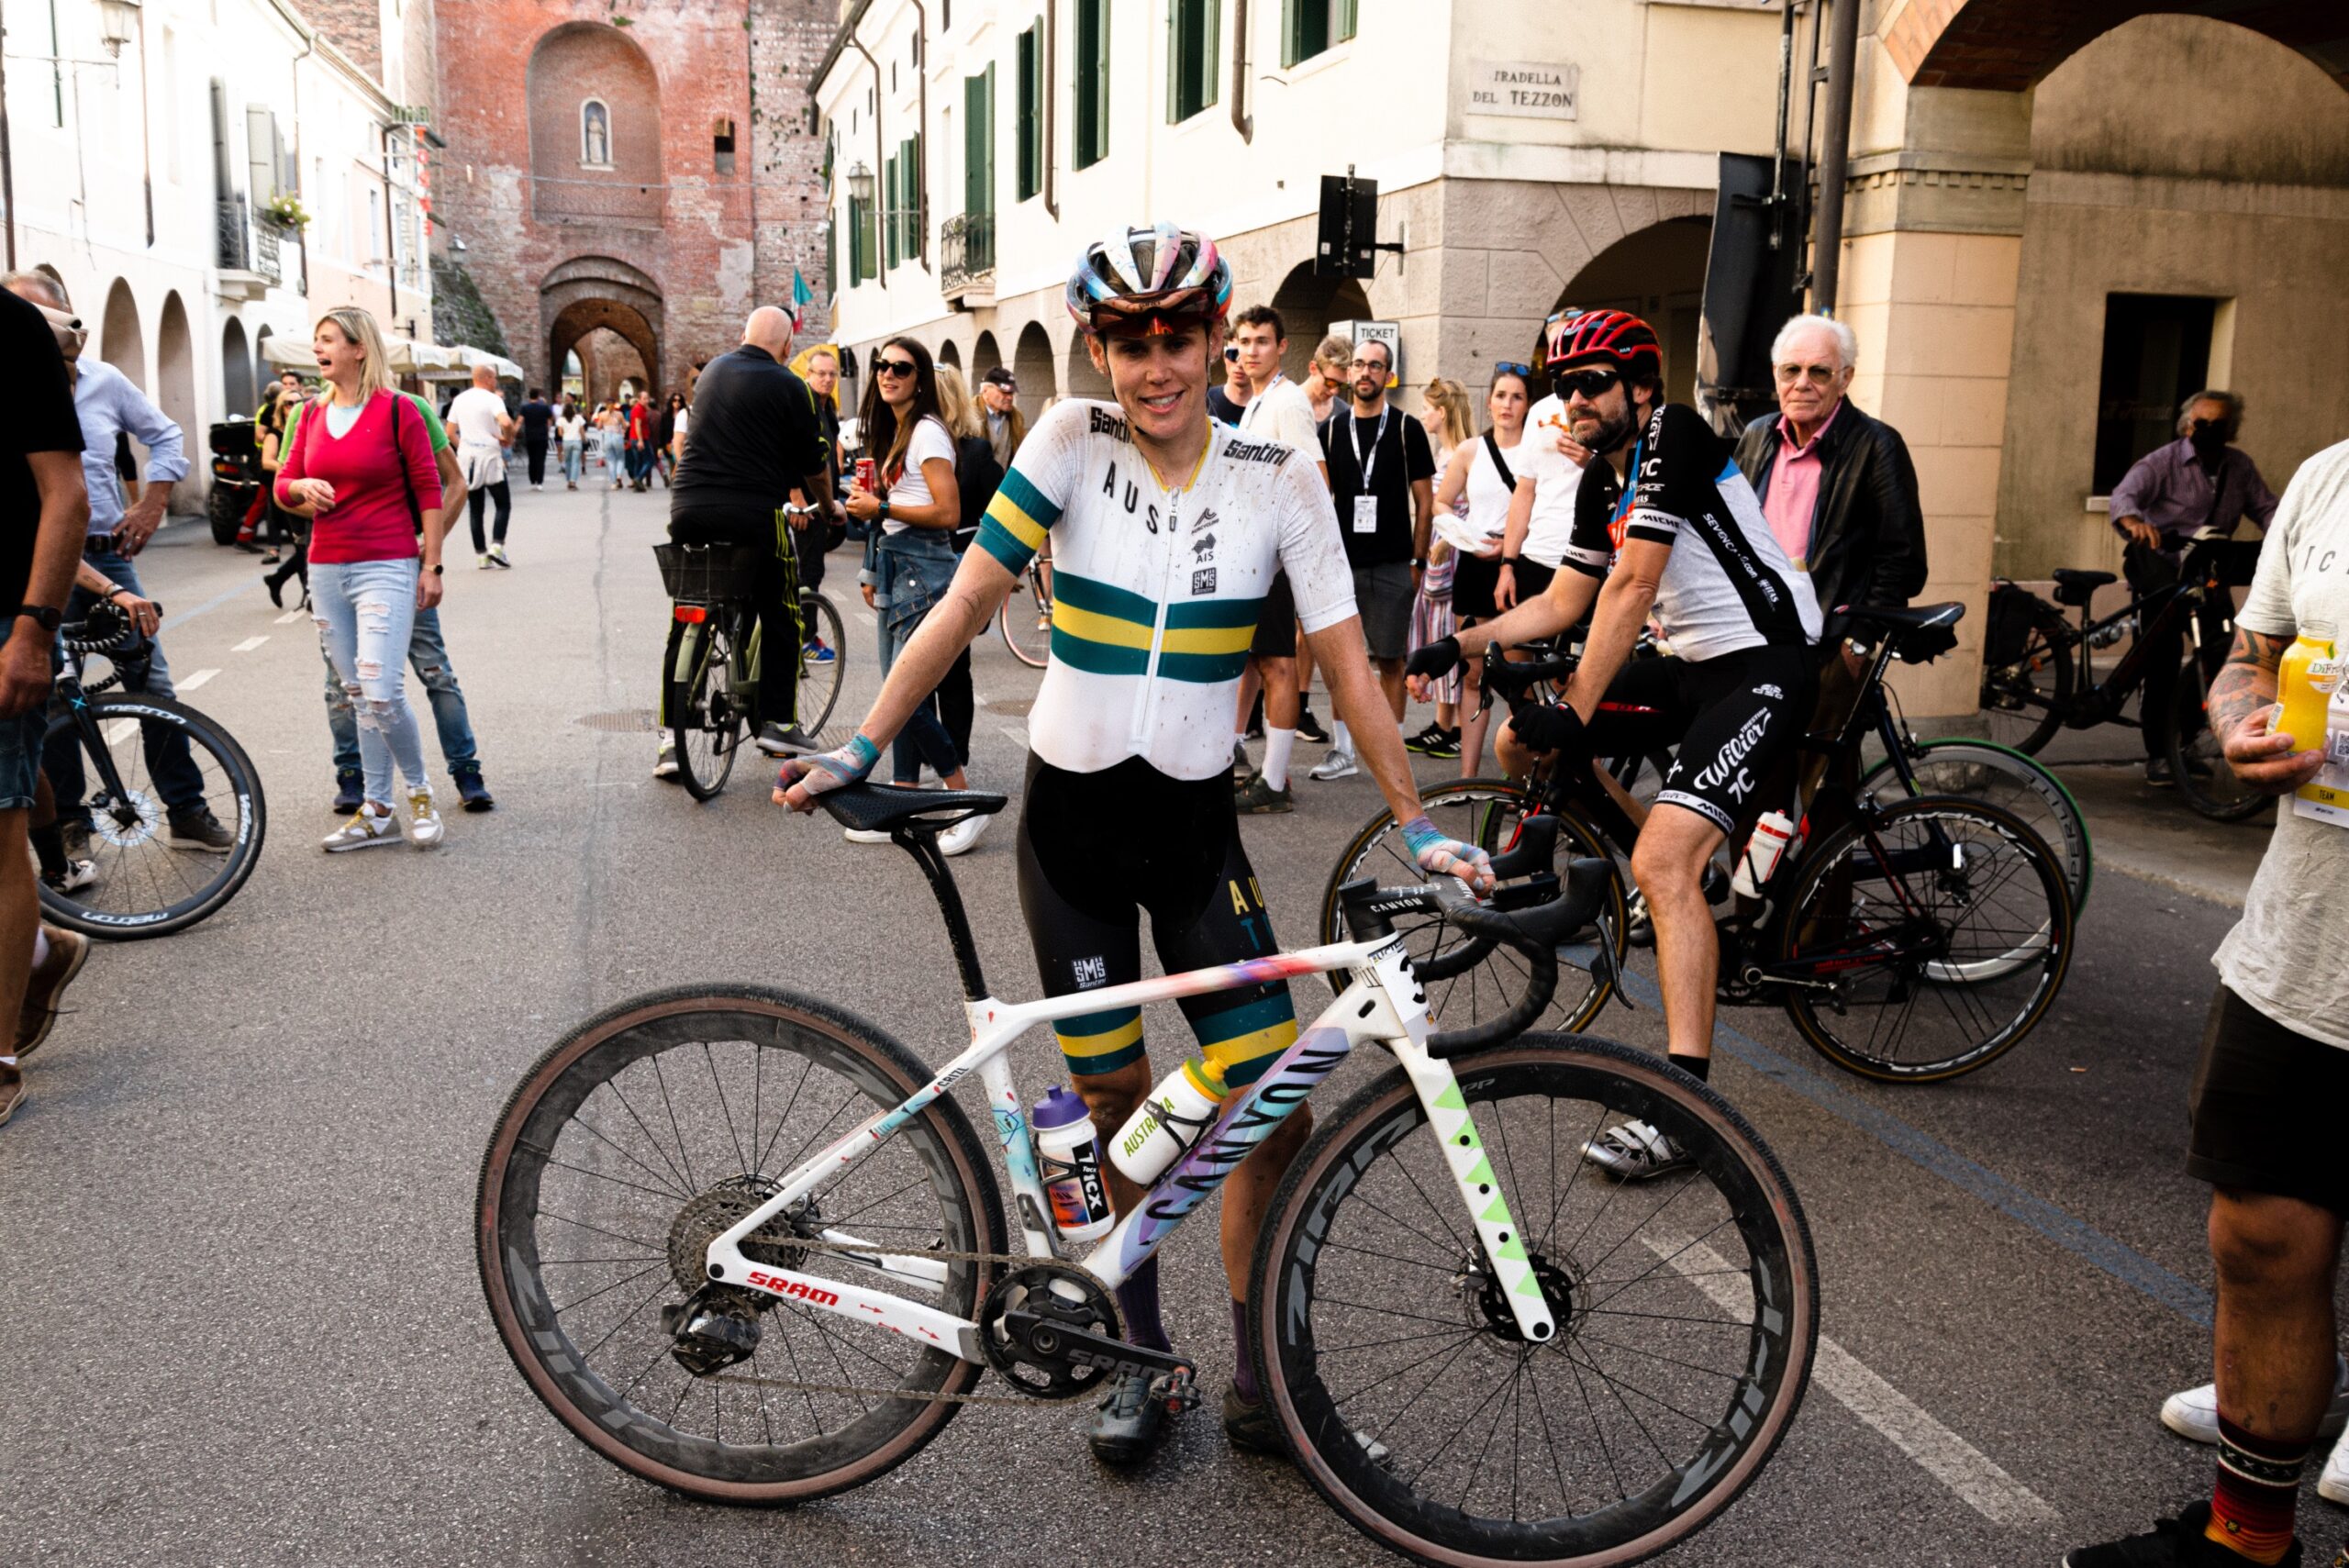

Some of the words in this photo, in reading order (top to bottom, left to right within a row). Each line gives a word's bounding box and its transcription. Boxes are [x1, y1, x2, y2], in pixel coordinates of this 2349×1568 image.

[1473, 91, 1498, 104] DEL
[1509, 90, 1573, 107] TEZZON
[1361, 328, 1395, 339] TICKET
[1223, 439, 1296, 467] Santini
[1103, 461, 1160, 535] AUS
[1641, 514, 1680, 529] MICHE
[1196, 551, 1214, 564] AIS
[1193, 568, 1216, 589] SMS
[103, 705, 186, 725] metron
[1694, 712, 1772, 790] Wilier
[1728, 767, 1755, 805] 7C
[2319, 789, 2335, 802] TEAM
[1370, 897, 1424, 913] CANYON
[82, 911, 169, 927] metron
[1073, 956, 1107, 983] SMS
[1079, 978, 1107, 989] Santini
[1145, 1048, 1350, 1221] CANYON
[747, 1271, 840, 1307] SRAM
[1067, 1348, 1173, 1379] SRAM
